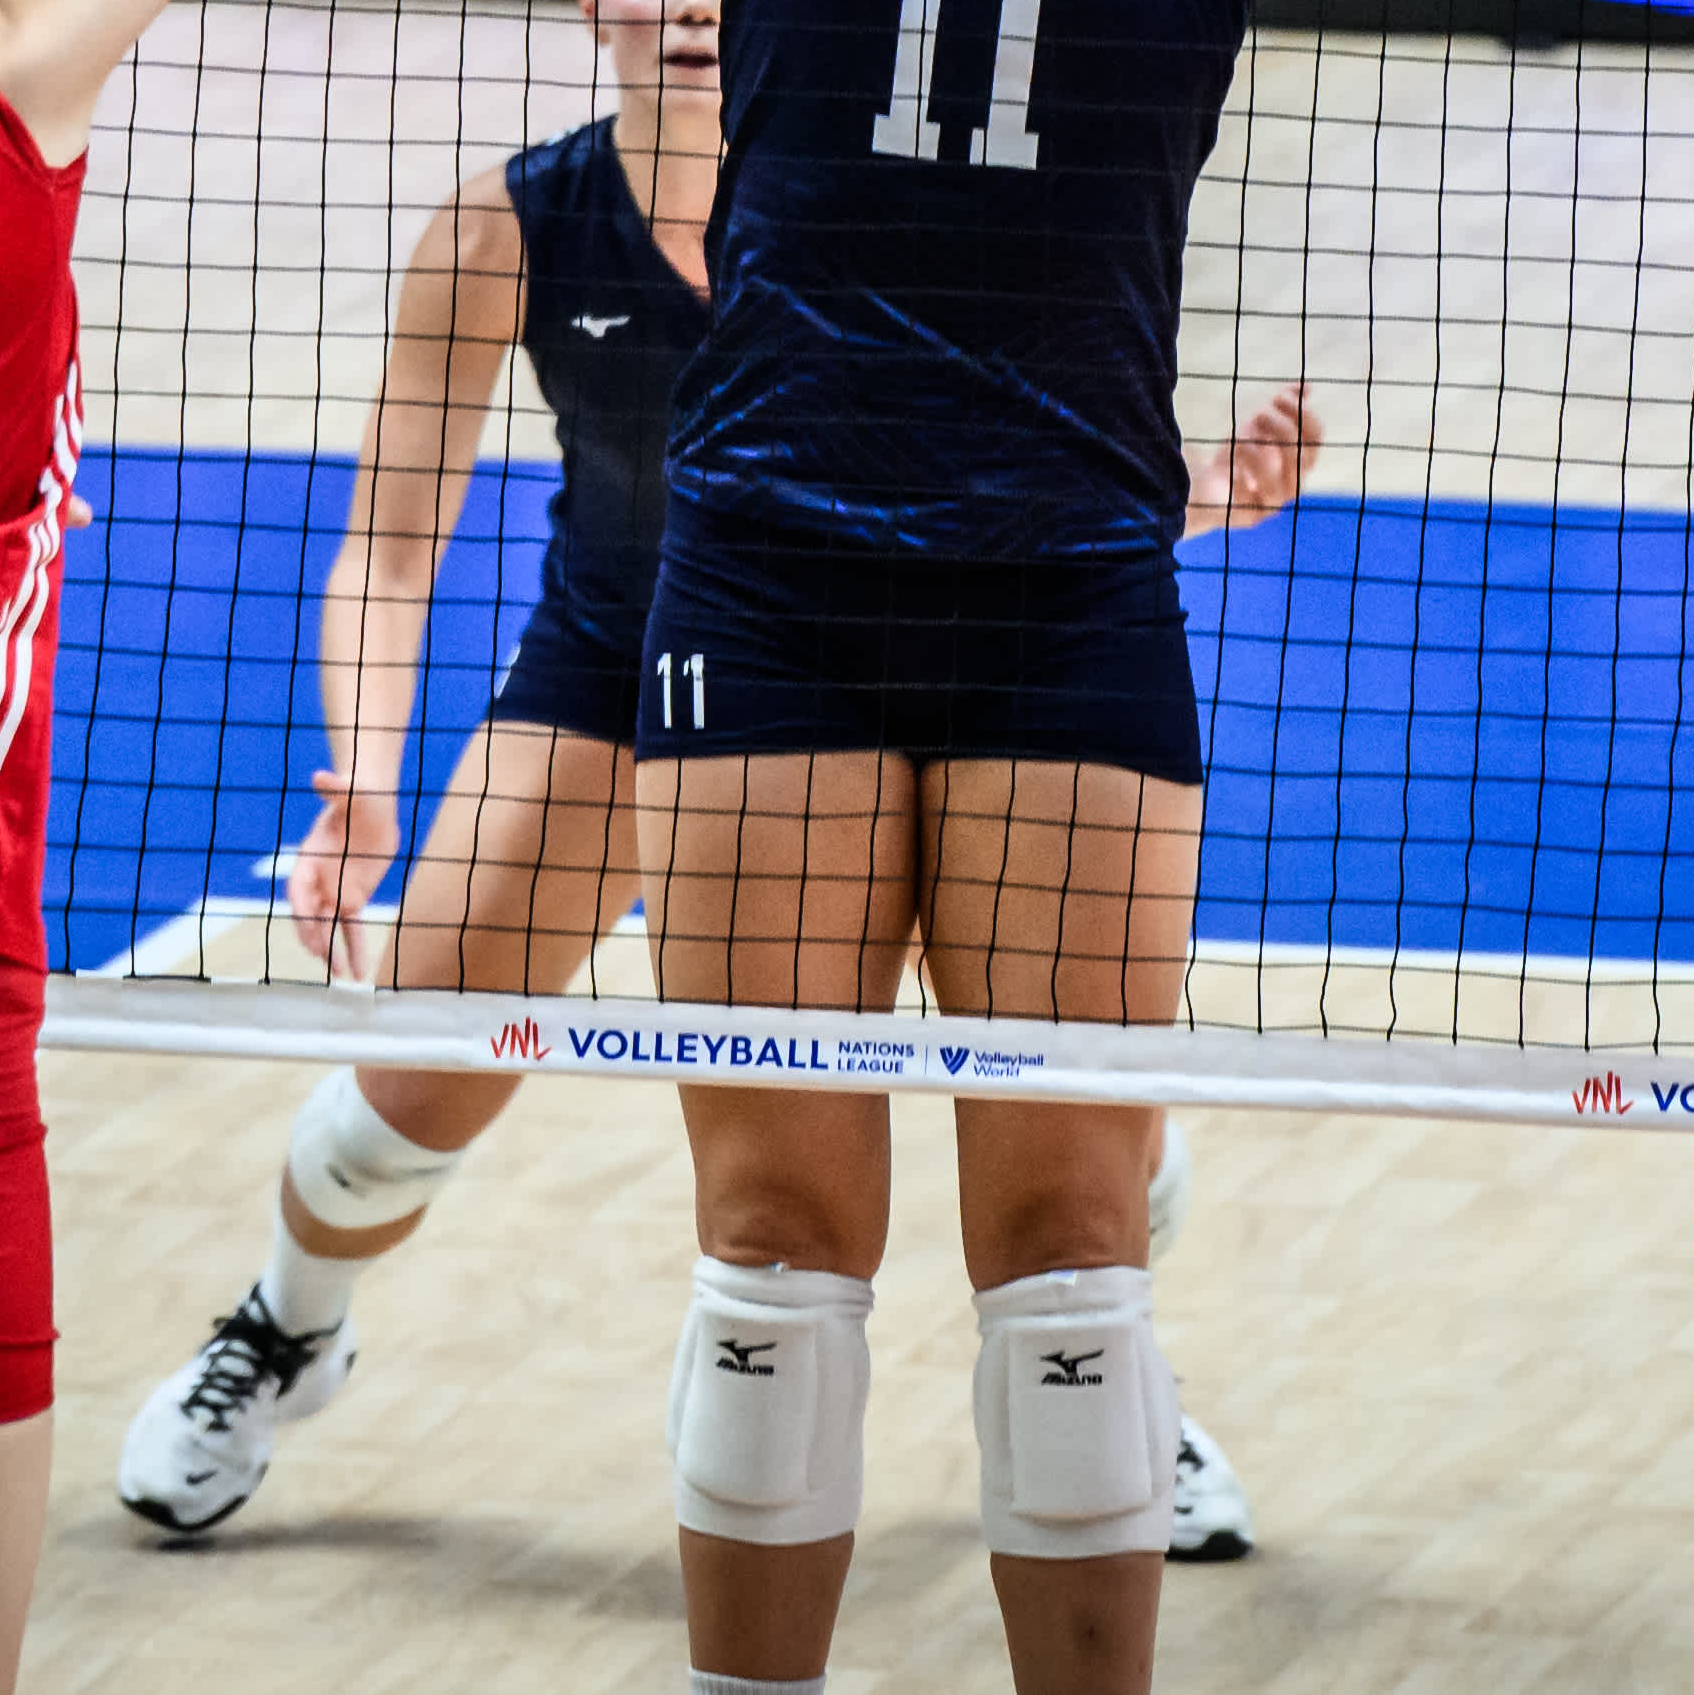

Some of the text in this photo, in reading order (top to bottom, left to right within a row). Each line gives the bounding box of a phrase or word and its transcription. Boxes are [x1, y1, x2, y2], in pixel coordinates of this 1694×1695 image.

[657, 653, 704, 729] 11
[490, 1016, 829, 1071] VNL VOLLEYBALL
[838, 1041, 915, 1058] NATIONS
[837, 1058, 904, 1075] LEAGUE
[974, 1050, 1044, 1068] Volleyball
[974, 1064, 1021, 1079] World
[1571, 1070, 1634, 1115] VNL
